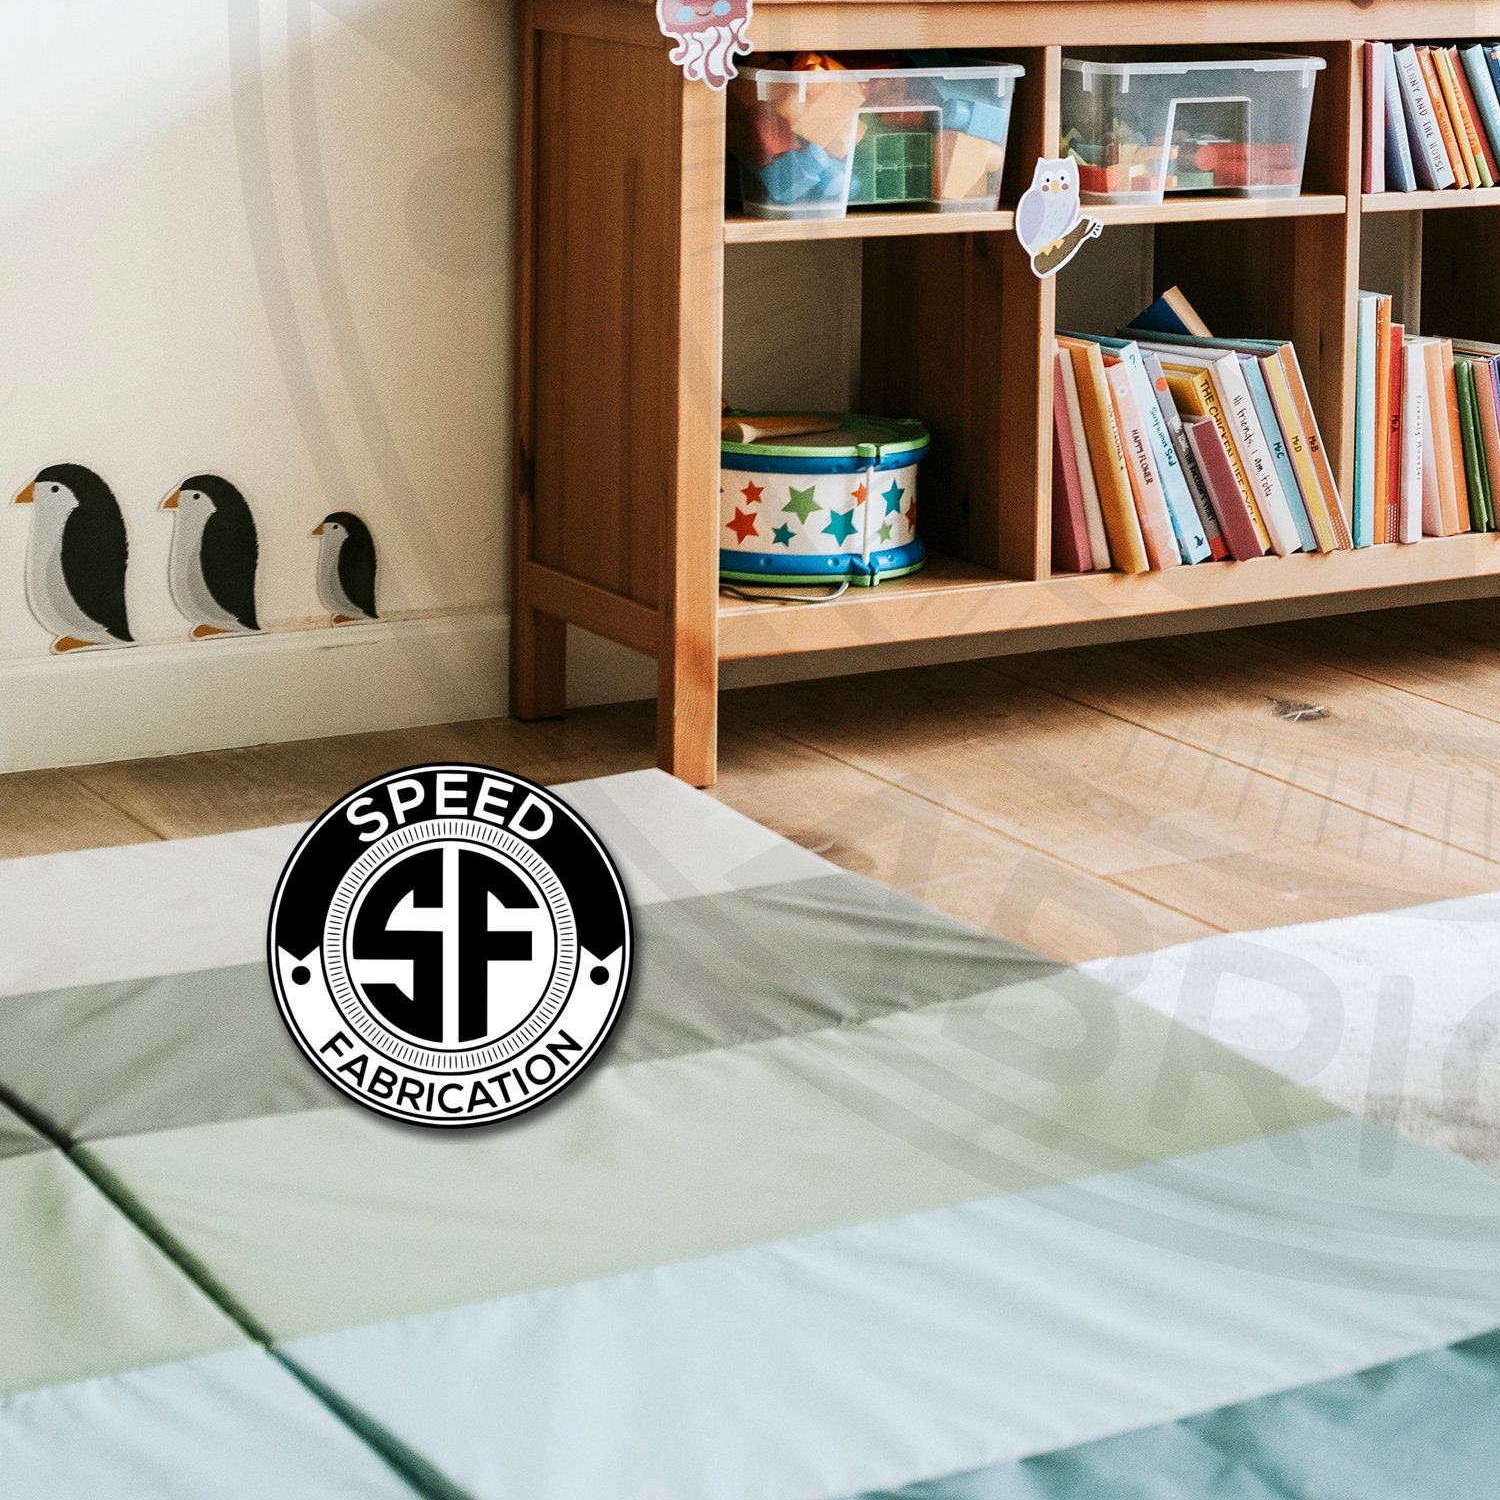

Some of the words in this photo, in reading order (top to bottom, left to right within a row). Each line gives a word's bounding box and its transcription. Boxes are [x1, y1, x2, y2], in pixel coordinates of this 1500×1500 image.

[1404, 64, 1420, 93] JENNY
[1415, 98, 1428, 116] AND
[1423, 121, 1434, 138] THE
[1428, 143, 1445, 173] HORSE
[1200, 379, 1215, 406] THE
[1209, 406, 1234, 460] CHICKEN
[1131, 428, 1144, 454] HAPPY
[1137, 452, 1153, 485] FLOWER
